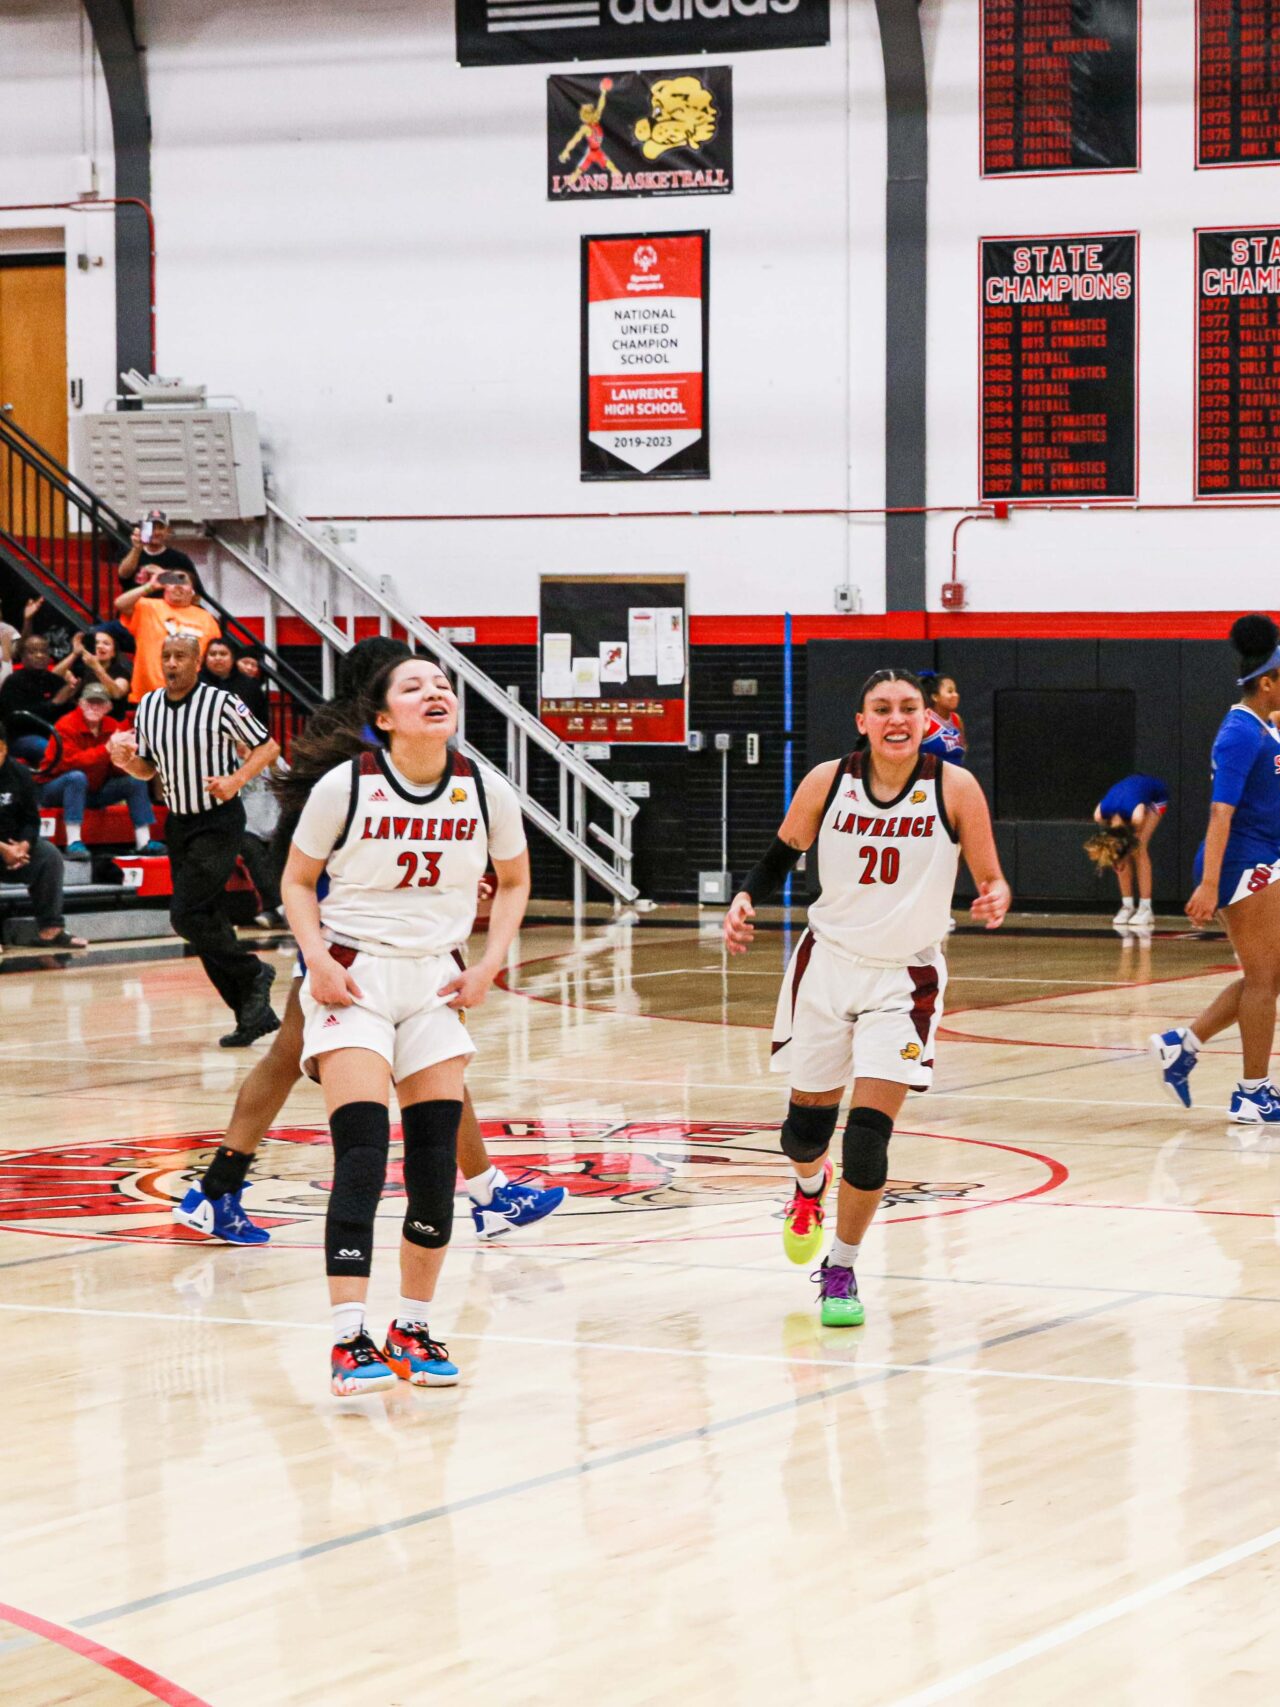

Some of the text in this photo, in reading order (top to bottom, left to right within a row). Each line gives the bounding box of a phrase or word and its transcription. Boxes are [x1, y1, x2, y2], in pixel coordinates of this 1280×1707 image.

[612, 169, 729, 190] BASKETBALL
[1014, 244, 1103, 273] STATE
[986, 272, 1131, 303] CHAMPIONS
[1201, 298, 1229, 311] 1977
[1240, 296, 1268, 309] GIRLS
[614, 309, 676, 321] NATIONAL
[1022, 304, 1070, 317] FOOTBALL
[1051, 319, 1106, 332] GYMNASTICS
[1201, 314, 1229, 327] 1977
[1240, 313, 1268, 326] GIRLS
[621, 323, 669, 335] UNIFIED
[1051, 335, 1106, 348] GYMNASTICS
[1201, 330, 1229, 343] 1977
[612, 338, 678, 350] CHAMPION
[621, 353, 669, 365] SCHOOL
[1022, 352, 1070, 365] FOOTBALL
[1051, 366, 1106, 379] GYMNASTICS
[611, 387, 678, 401] LAWRENCE
[1022, 383, 1070, 396] FOOTBALL
[604, 402, 686, 415] HIGH SCHOOL
[1022, 398, 1070, 412] FOOTBALL
[1051, 413, 1106, 427] GYMNASTICS
[614, 436, 672, 448] 2019-2023
[1051, 429, 1106, 442] GYMNASTICS
[1022, 446, 1070, 459] FOOTBALL
[1051, 460, 1106, 474] GYMNASTICS
[1051, 476, 1106, 489] GYMNASTICS
[361, 816, 478, 840] LAWRENCE
[832, 810, 936, 837] LAWRENCE
[395, 851, 443, 889] 23
[859, 845, 900, 885] 20
